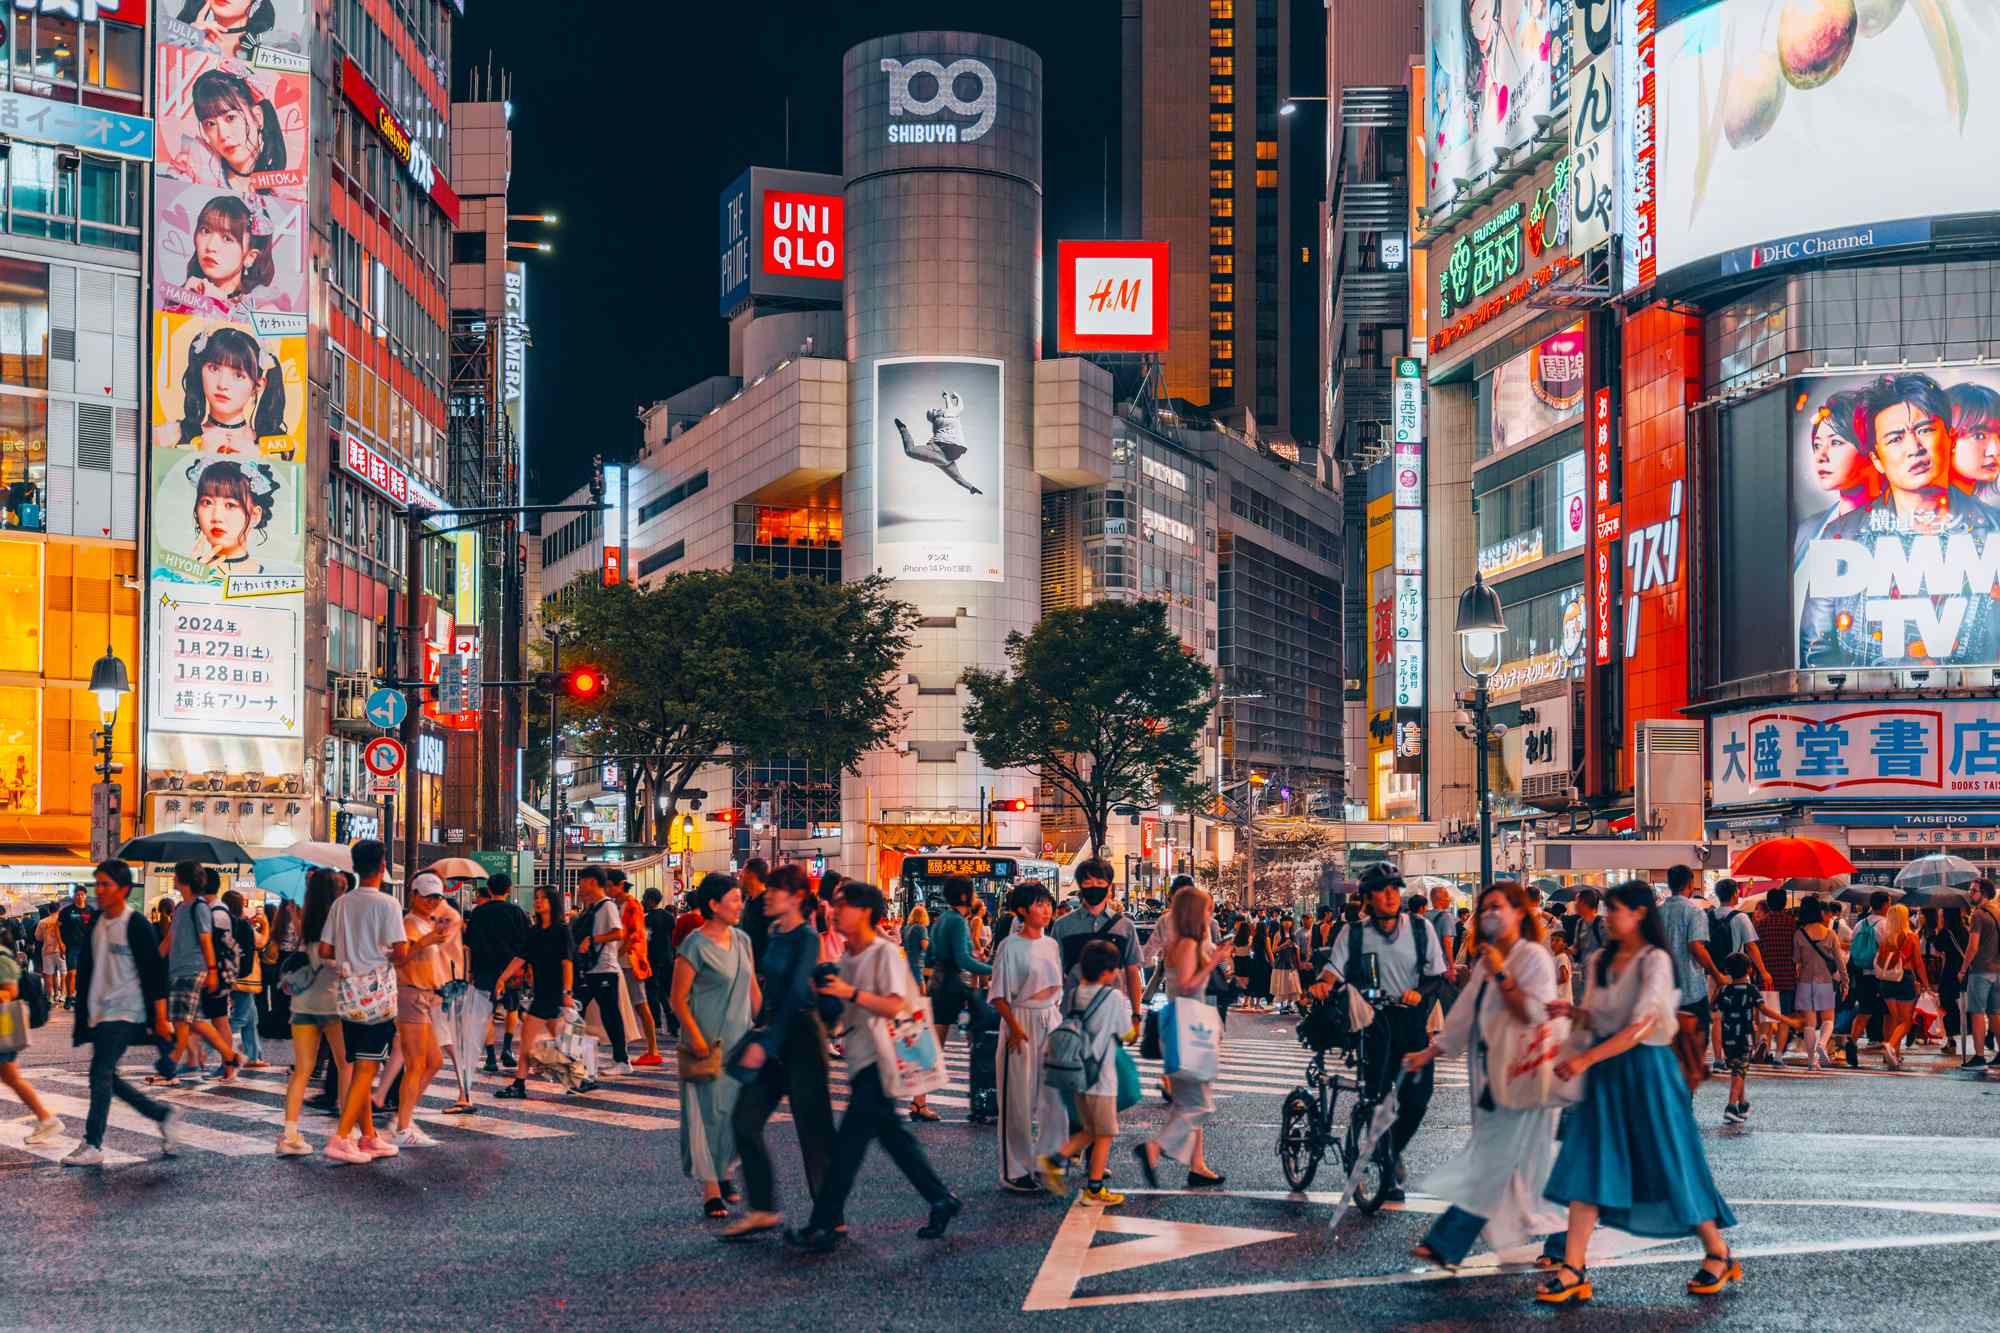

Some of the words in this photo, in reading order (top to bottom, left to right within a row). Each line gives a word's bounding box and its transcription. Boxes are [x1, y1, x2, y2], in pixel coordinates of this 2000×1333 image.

[166, 19, 200, 42] JULIA
[880, 57, 997, 142] 109
[888, 124, 956, 143] SHIBUYA
[257, 174, 299, 187] HITOKA
[727, 191, 744, 239] THE
[773, 202, 830, 235] UNI
[773, 237, 835, 270] QLO
[1763, 241, 1798, 264] DHC
[1803, 229, 1874, 254] Channel
[721, 236, 750, 298] PRIME
[165, 287, 209, 311] HARUKA
[506, 272, 520, 307] BIC
[1088, 278, 1141, 313] H&M
[505, 312, 520, 400] CAMERA
[165, 553, 205, 576] HIYORI
[1808, 534, 2000, 598] DMM
[178, 615, 237, 633] 2024年
[1864, 598, 1968, 657] TV
[178, 638, 271, 660] 1月27日(土)
[178, 662, 270, 683] 1月28日(日)
[176, 690, 279, 712] 横浜アリーナ
[419, 733, 444, 775] USH
[1722, 718, 2000, 784] 大盛堂書店
[1952, 781, 1980, 791] BOOKS
